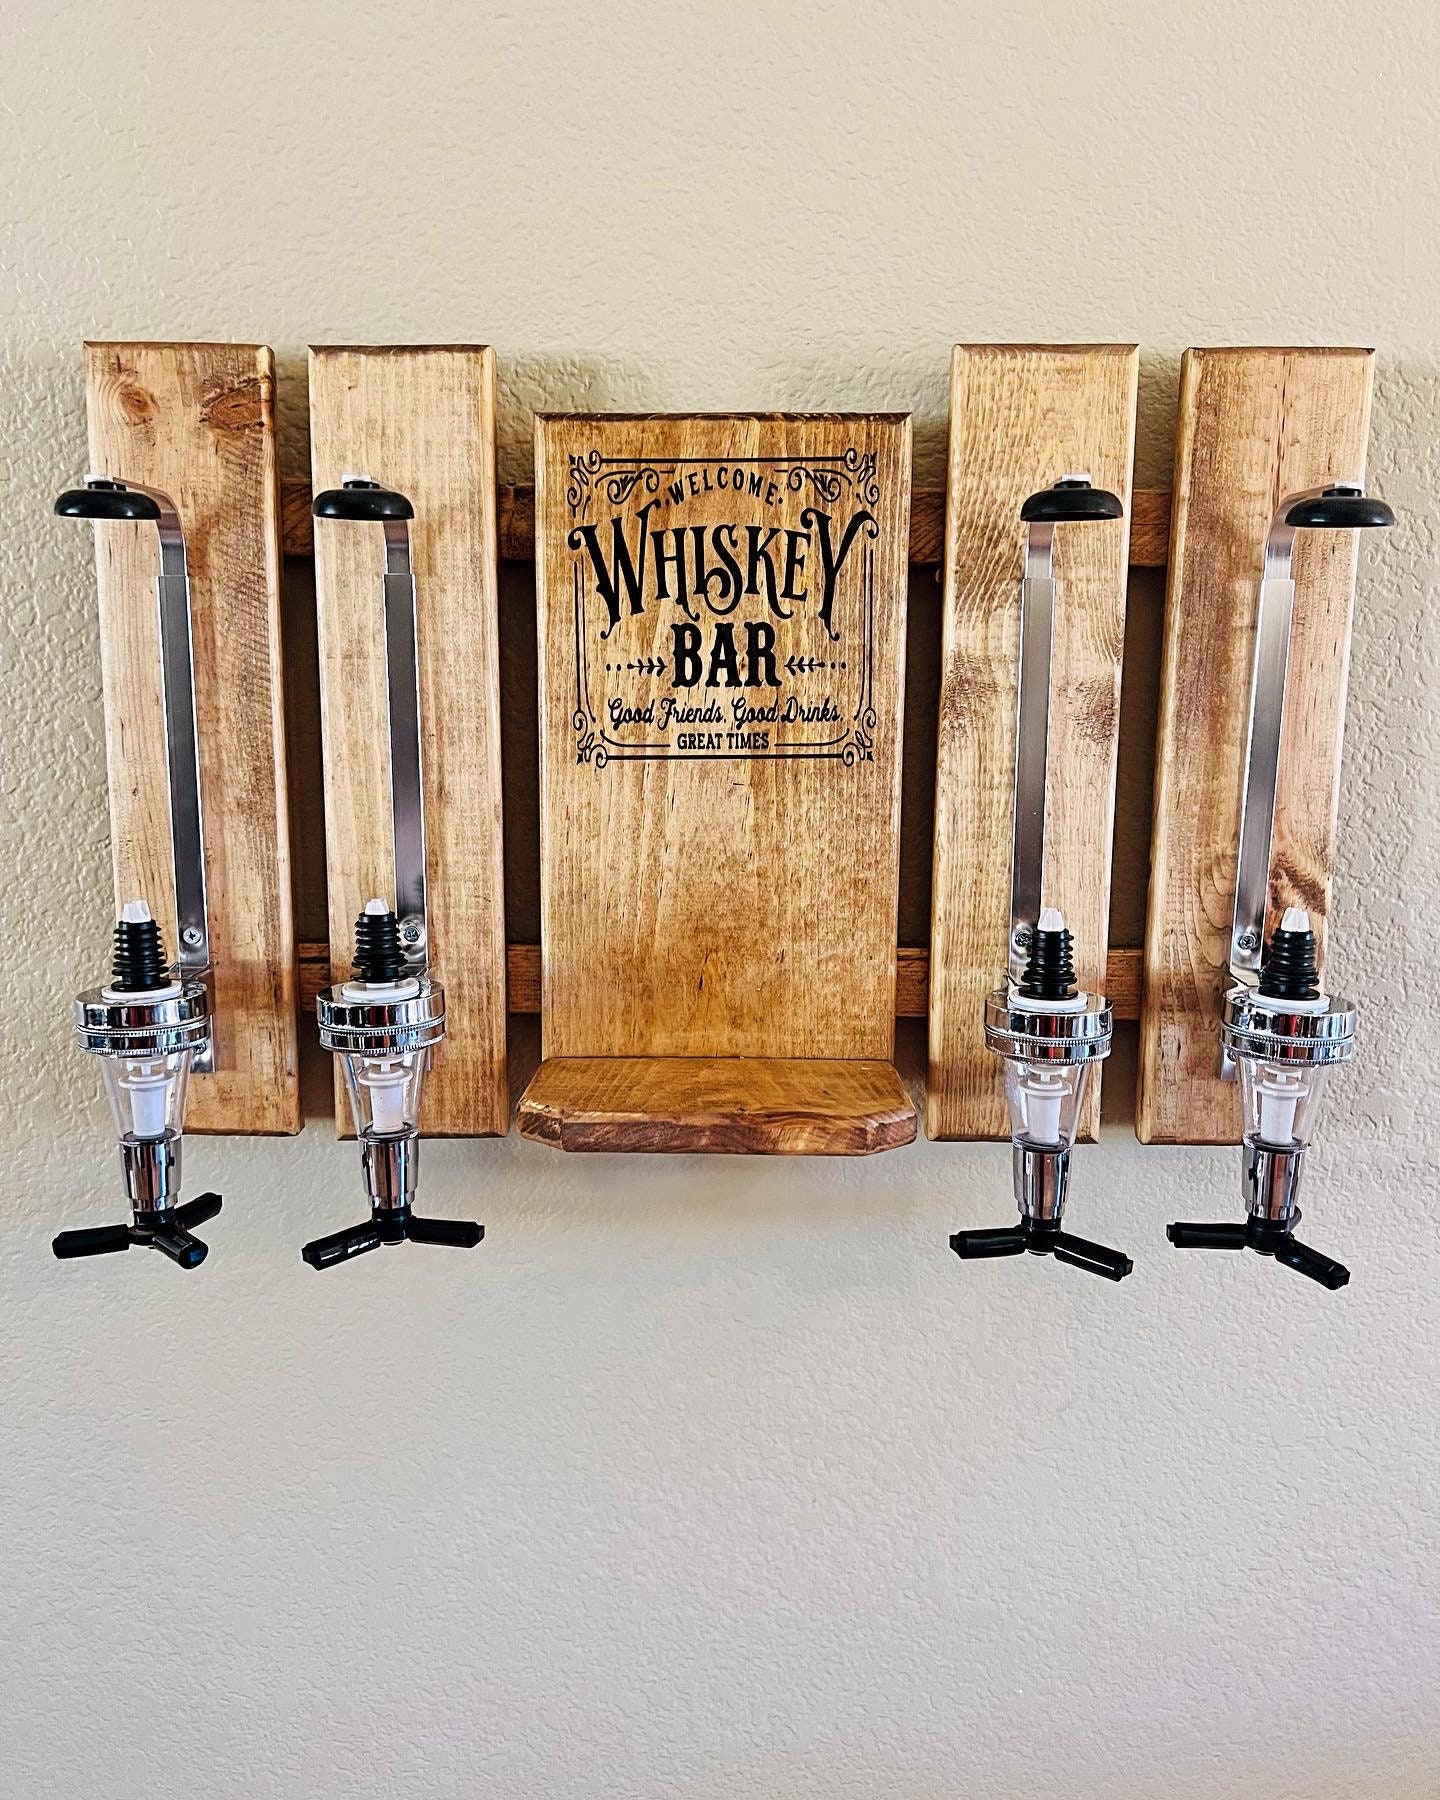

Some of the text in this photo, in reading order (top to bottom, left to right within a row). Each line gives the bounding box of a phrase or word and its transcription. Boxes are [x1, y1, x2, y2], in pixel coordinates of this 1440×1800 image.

[668, 467, 779, 506] WELCOME
[568, 498, 880, 642] WHISKEY
[670, 621, 782, 688] BAR
[608, 698, 655, 730] Good
[732, 696, 779, 730] Good
[677, 732, 770, 750] GREAT TIMES
